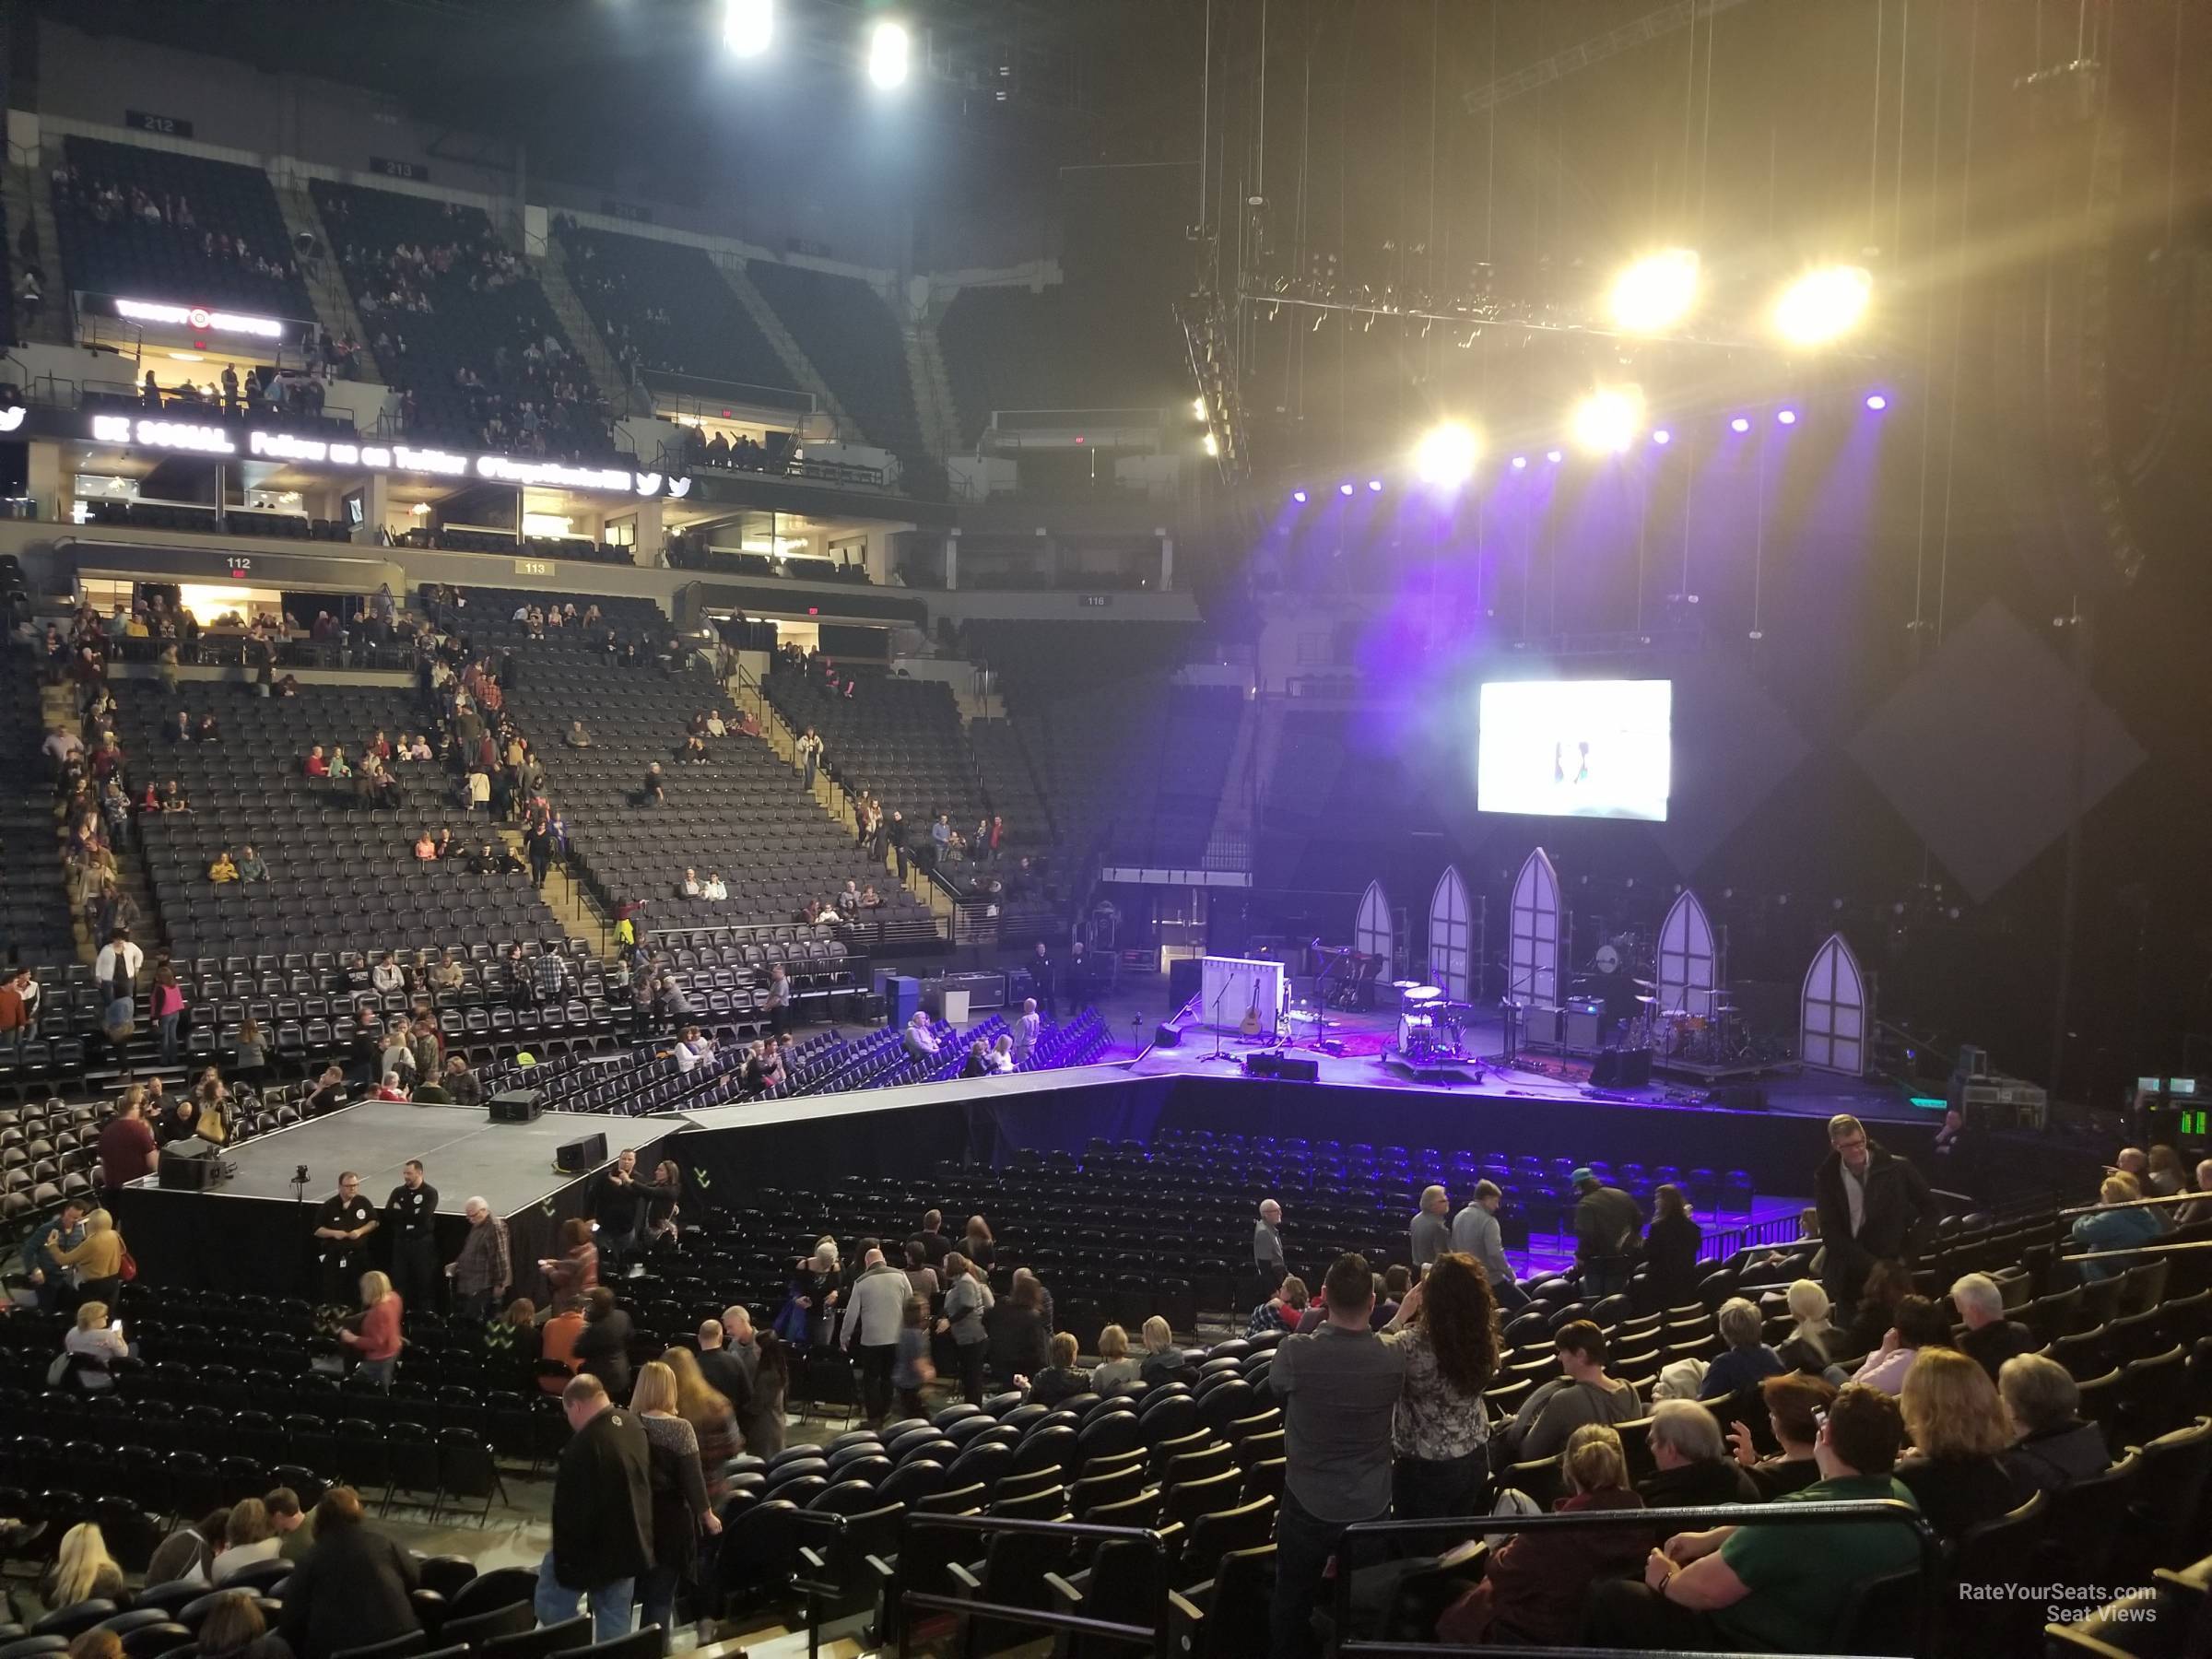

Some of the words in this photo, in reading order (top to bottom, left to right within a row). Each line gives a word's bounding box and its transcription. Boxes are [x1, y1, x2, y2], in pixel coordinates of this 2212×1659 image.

[145, 116, 174, 132] 212
[387, 161, 412, 176] 213
[226, 557, 251, 569] 112
[525, 563, 545, 574] 113
